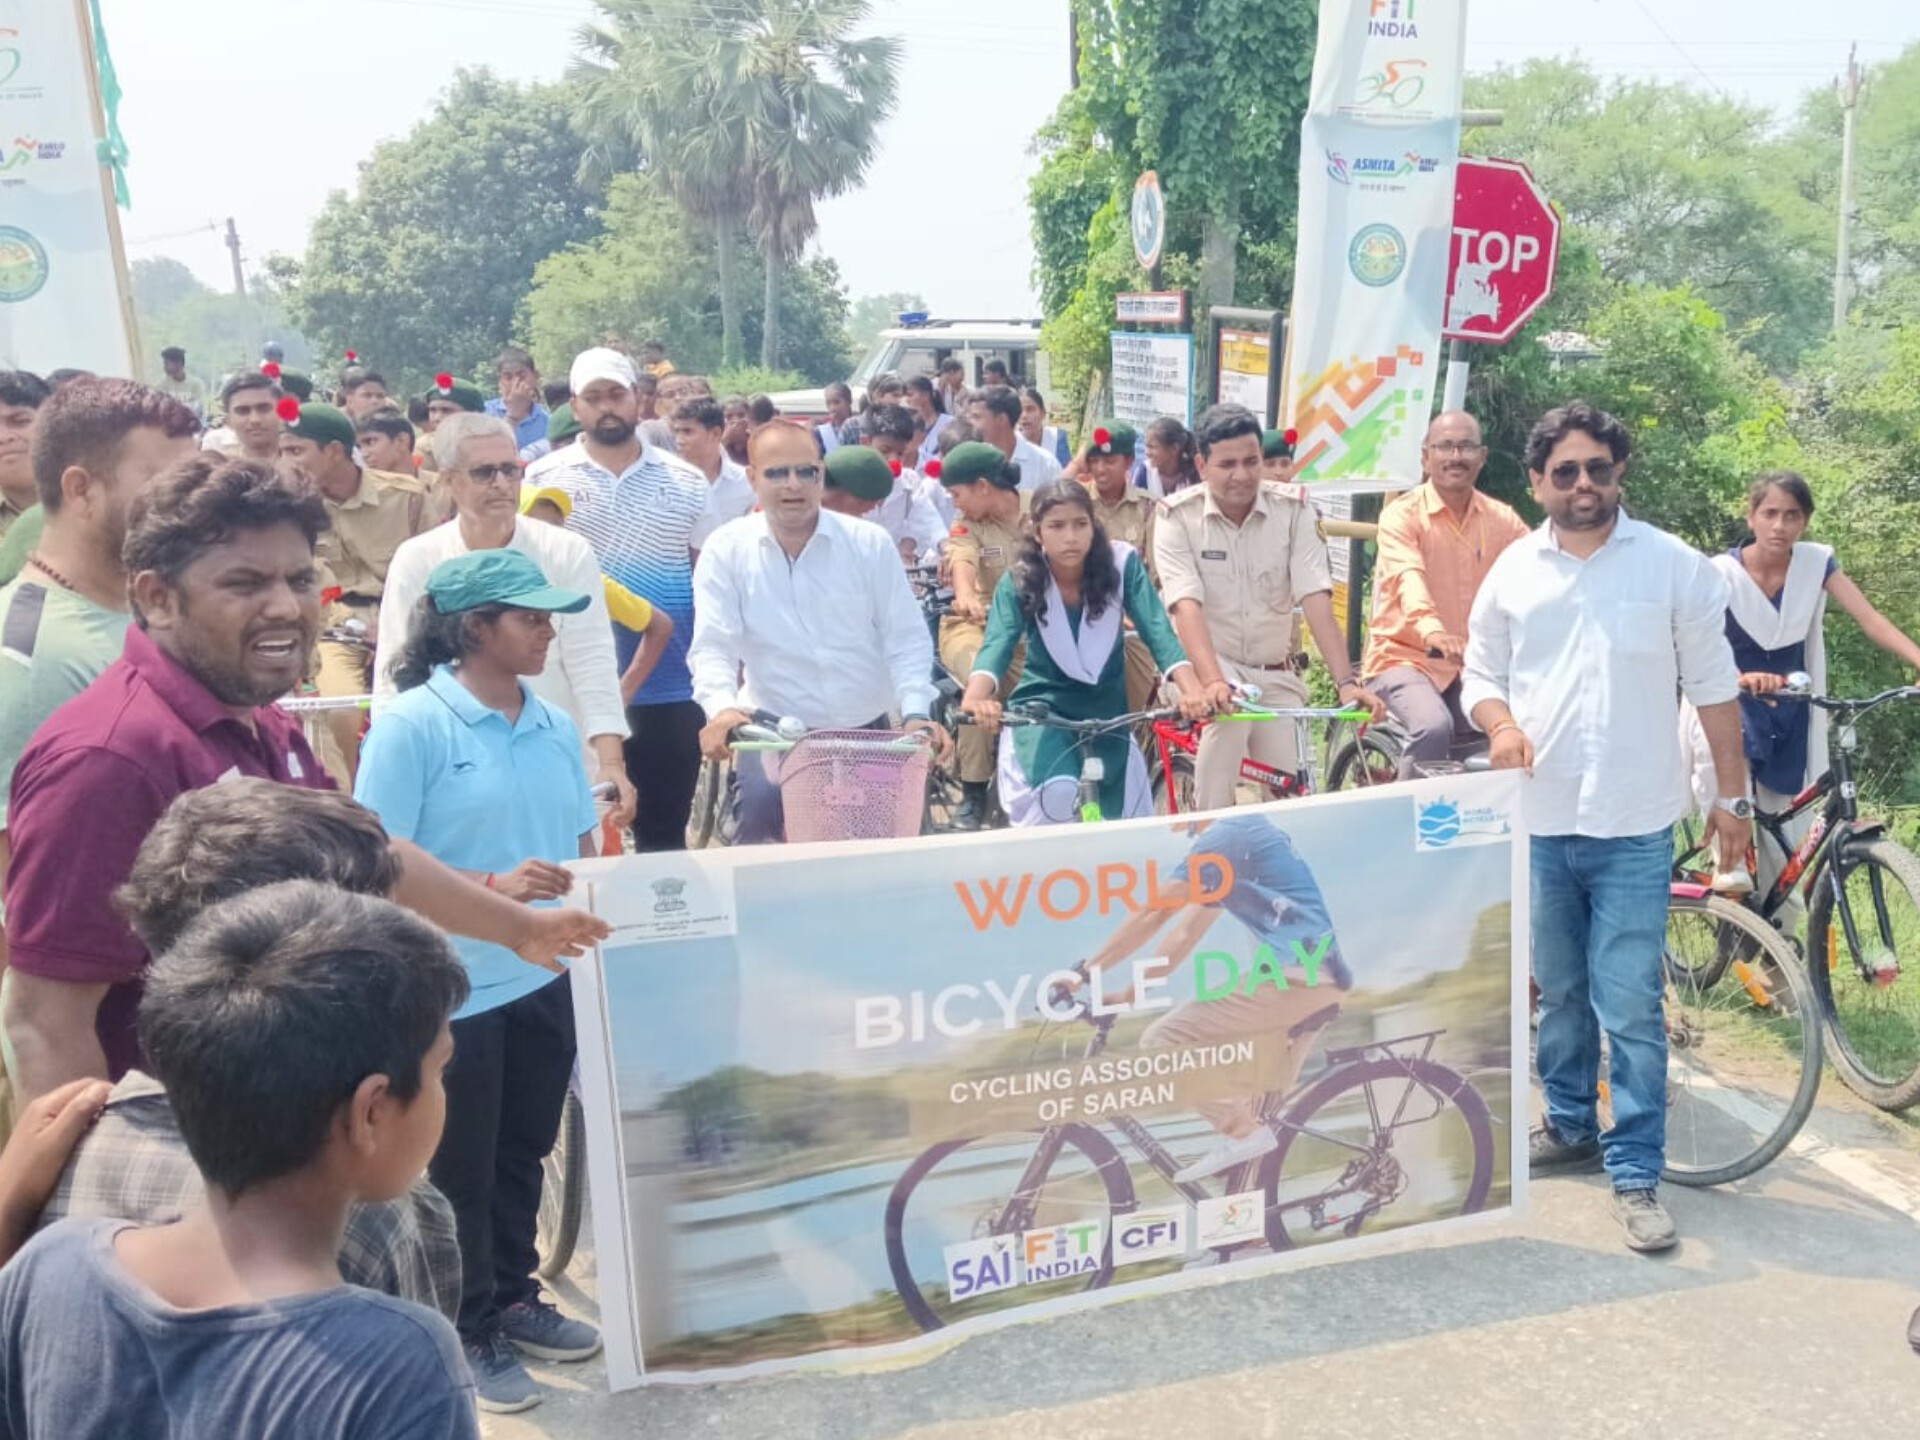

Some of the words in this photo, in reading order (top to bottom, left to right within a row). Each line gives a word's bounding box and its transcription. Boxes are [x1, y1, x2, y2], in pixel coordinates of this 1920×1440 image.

[1368, 20, 1418, 39] INDIA
[1353, 158, 1395, 171] ASMITA
[1453, 226, 1540, 273] TOP
[954, 853, 1235, 932] WORLD
[854, 956, 1173, 1049] BICYCLE
[1194, 936, 1333, 1003] DAY
[950, 1067, 1071, 1105] CYCLING
[1080, 1040, 1255, 1086] ASSOCIATION
[1038, 1097, 1074, 1122] OF
[1083, 1083, 1175, 1116] SARAN
[1120, 1221, 1177, 1249] CFI
[952, 1251, 1011, 1295] SAI
[1028, 1256, 1097, 1282] INDIA
